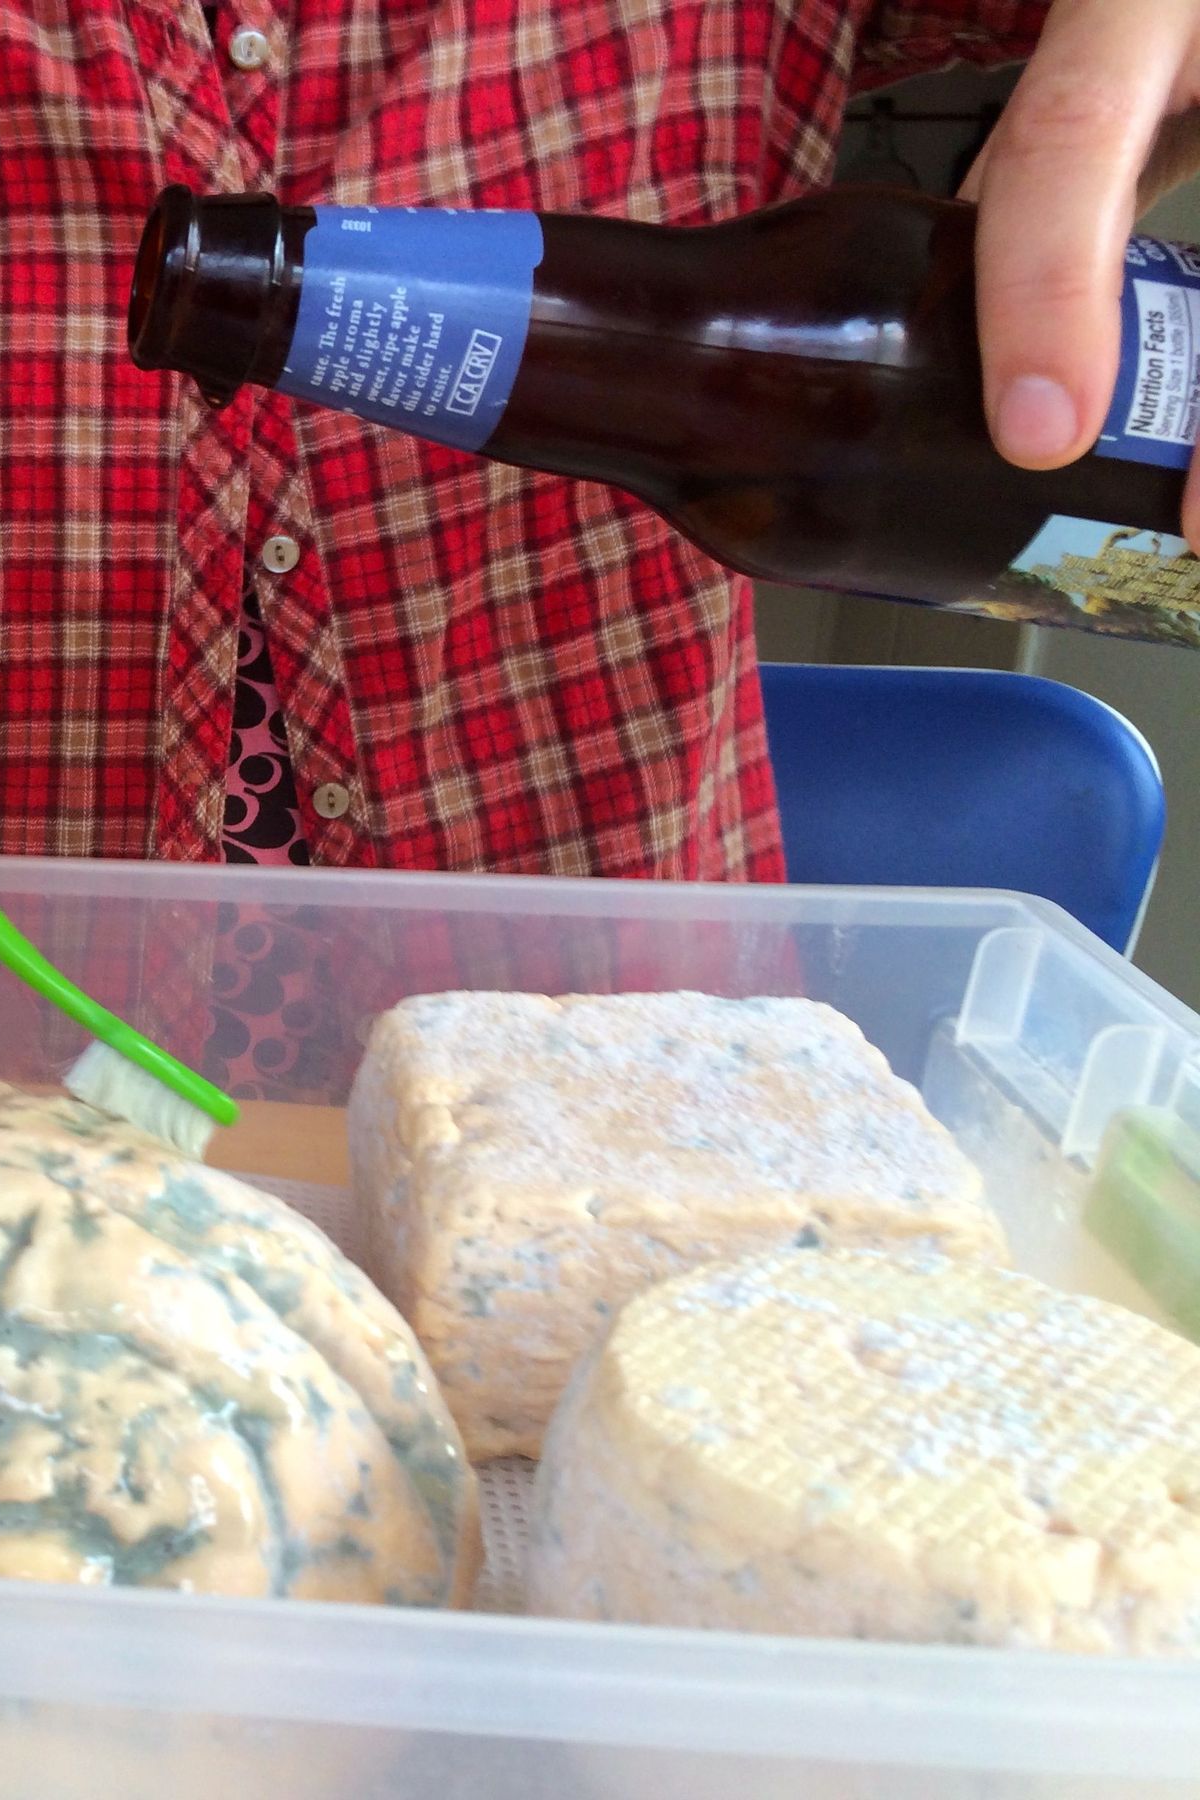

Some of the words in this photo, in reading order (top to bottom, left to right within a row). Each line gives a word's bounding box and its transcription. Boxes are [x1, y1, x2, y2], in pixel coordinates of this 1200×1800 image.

[325, 276, 347, 318] fresh
[389, 286, 410, 330] apple
[318, 321, 339, 349] The
[329, 356, 350, 392] apple
[343, 299, 364, 352] aroma
[356, 301, 388, 369] slightly
[380, 332, 400, 363] ripe
[422, 312, 445, 350] hard
[1143, 310, 1166, 353] Facts
[380, 371, 408, 407] flavor
[402, 325, 421, 368] make
[414, 352, 435, 388] cider
[465, 342, 493, 379] CRV
[348, 371, 366, 397] and
[399, 390, 422, 412] this
[423, 404, 437, 417] to
[431, 364, 453, 404] resist.
[455, 382, 481, 405] CA
[1129, 358, 1164, 434] Nutrition
